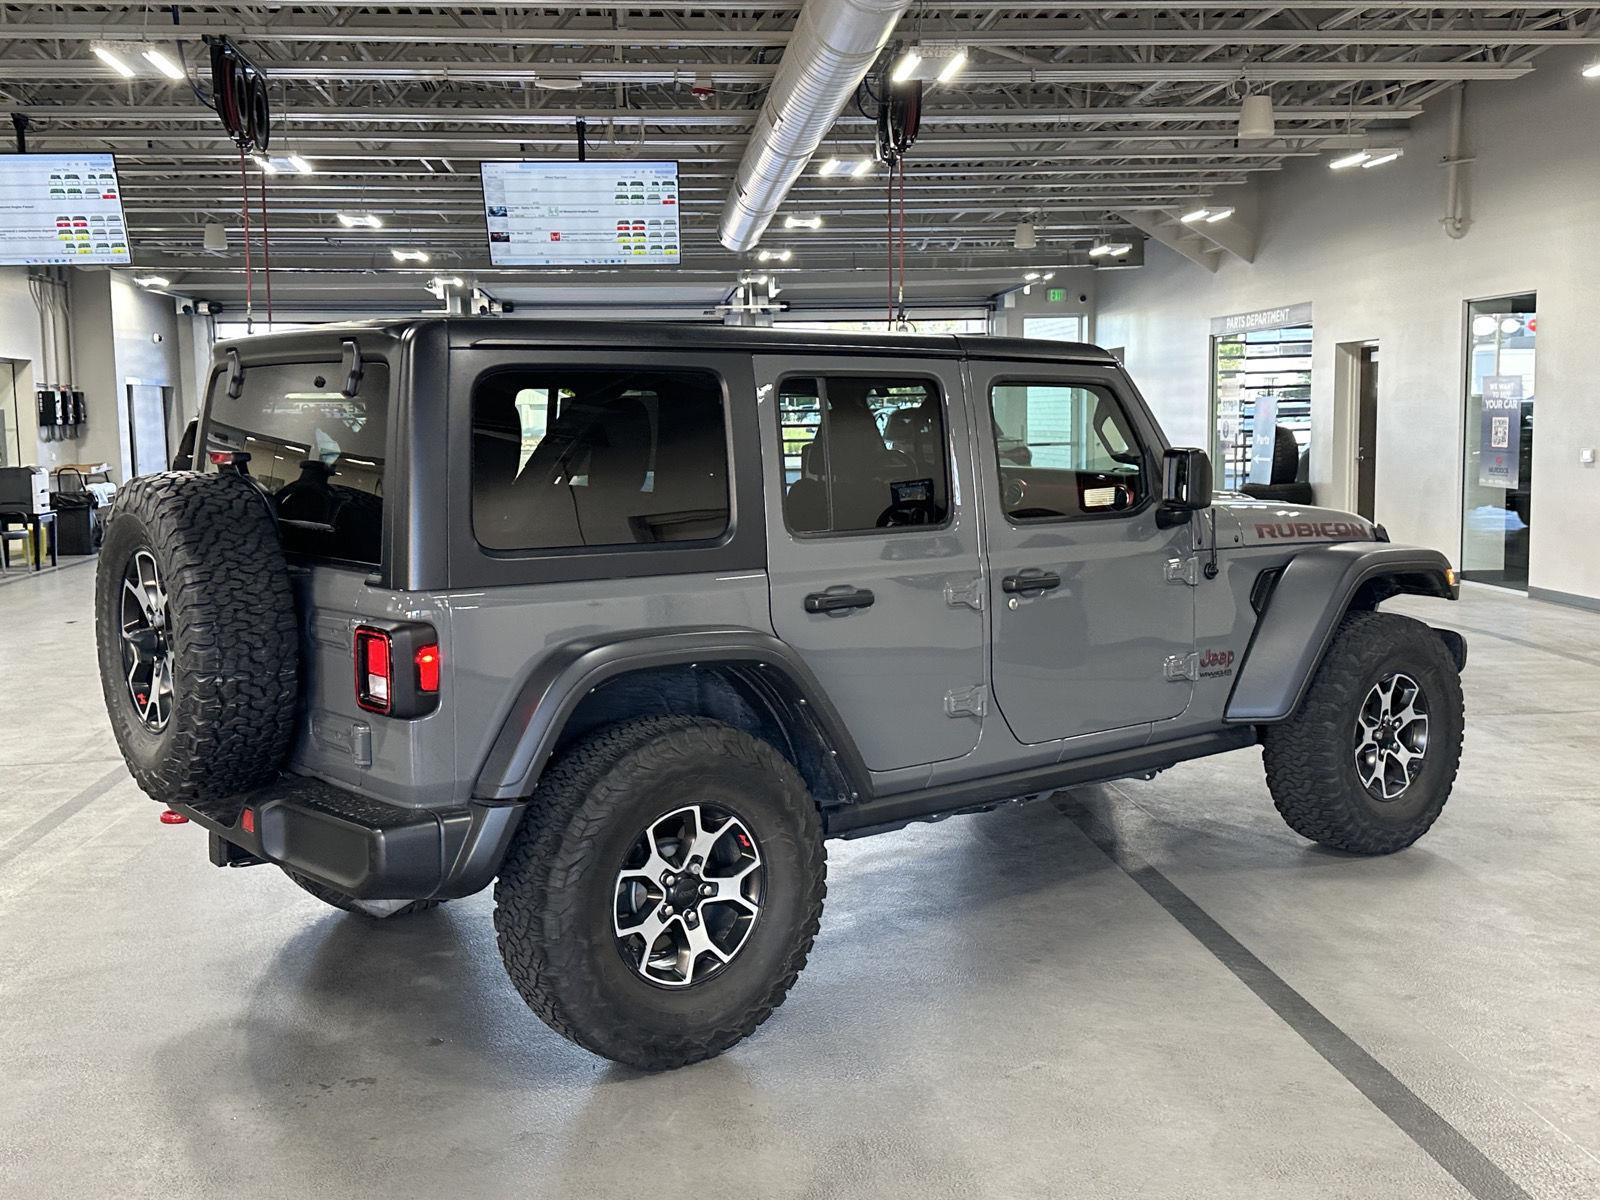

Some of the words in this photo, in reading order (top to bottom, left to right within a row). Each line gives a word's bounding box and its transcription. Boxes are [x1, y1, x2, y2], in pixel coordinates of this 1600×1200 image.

[1226, 315, 1246, 329] PARTS
[1246, 309, 1290, 327] DEPARTMENT
[1485, 400, 1503, 409] YOUR
[1503, 400, 1518, 409] CAR
[1254, 522, 1370, 538] RUBICON
[1200, 649, 1234, 667] Jeep
